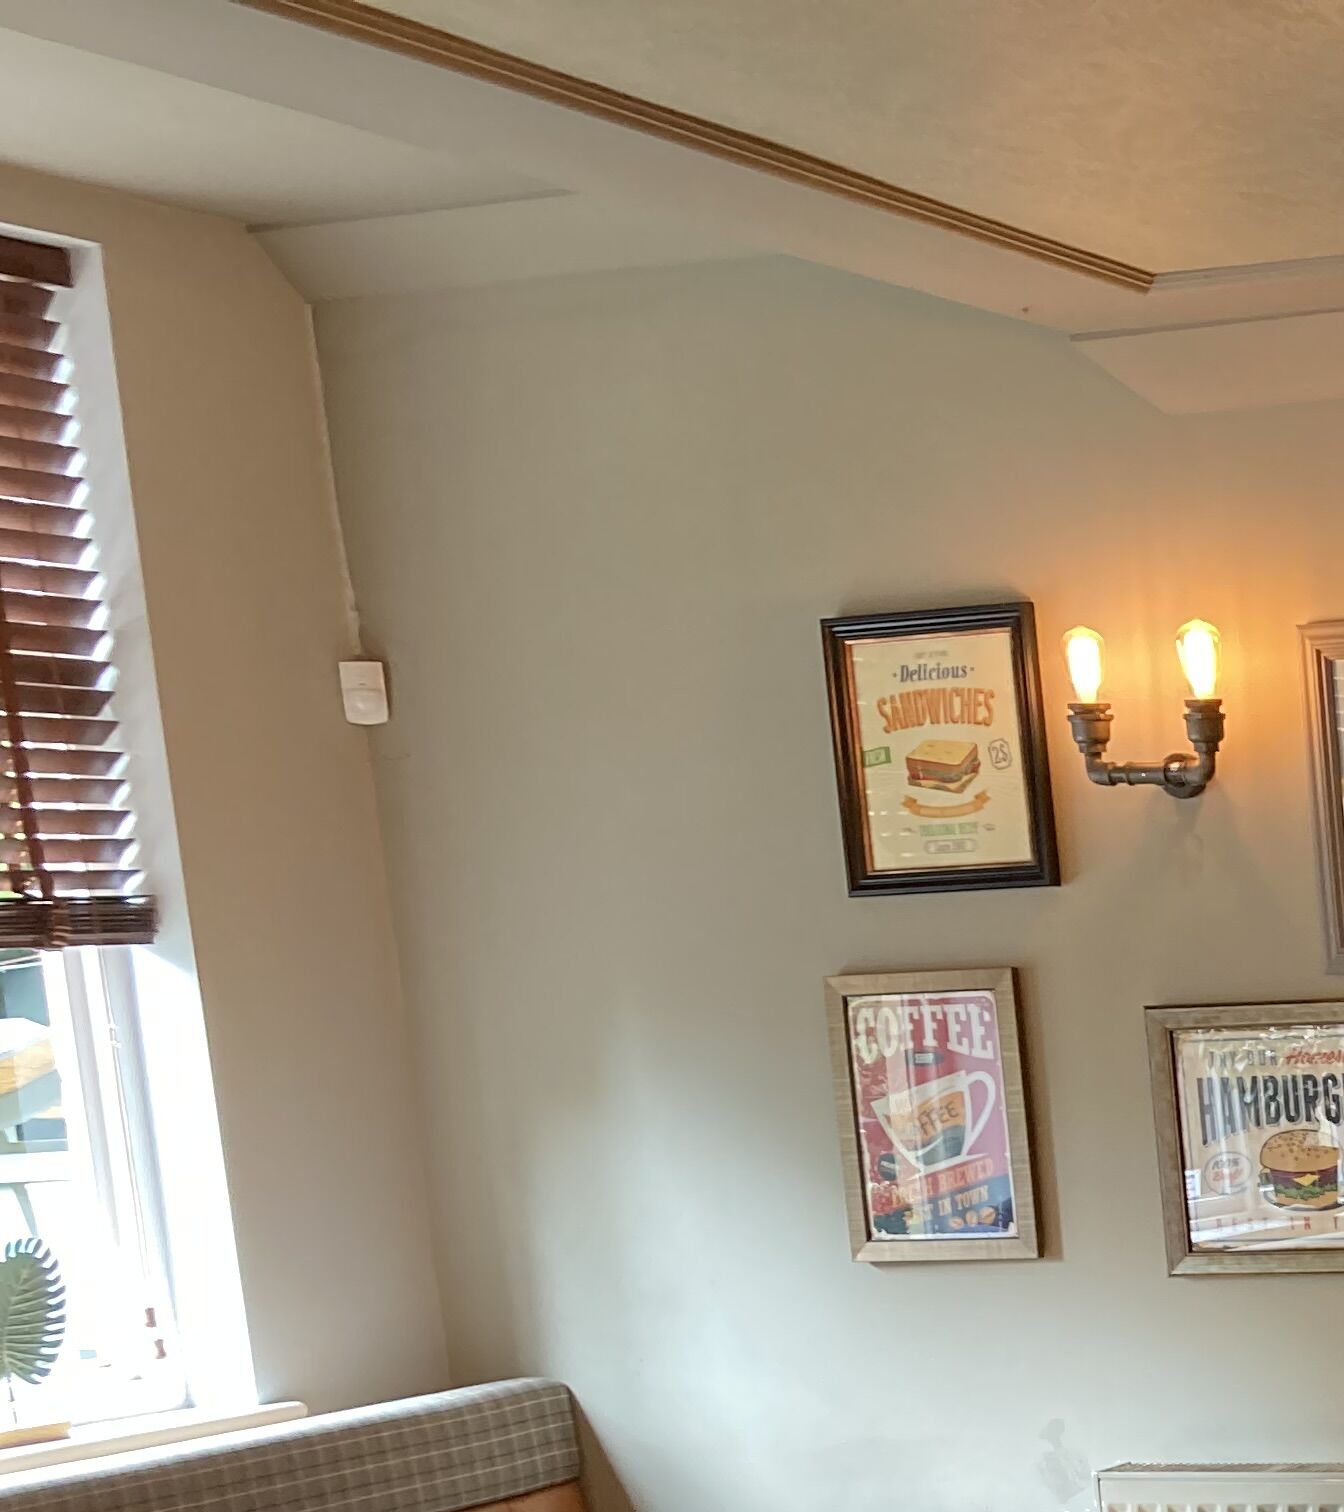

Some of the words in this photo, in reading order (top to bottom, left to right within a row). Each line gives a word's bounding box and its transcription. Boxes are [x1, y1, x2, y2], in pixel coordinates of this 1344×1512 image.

[900, 663, 968, 683] Delicious
[876, 687, 995, 733] SANDWICHES
[855, 1003, 995, 1064] COFFEE
[940, 1157, 993, 1194] BREWED
[954, 1185, 989, 1210] TOWN
